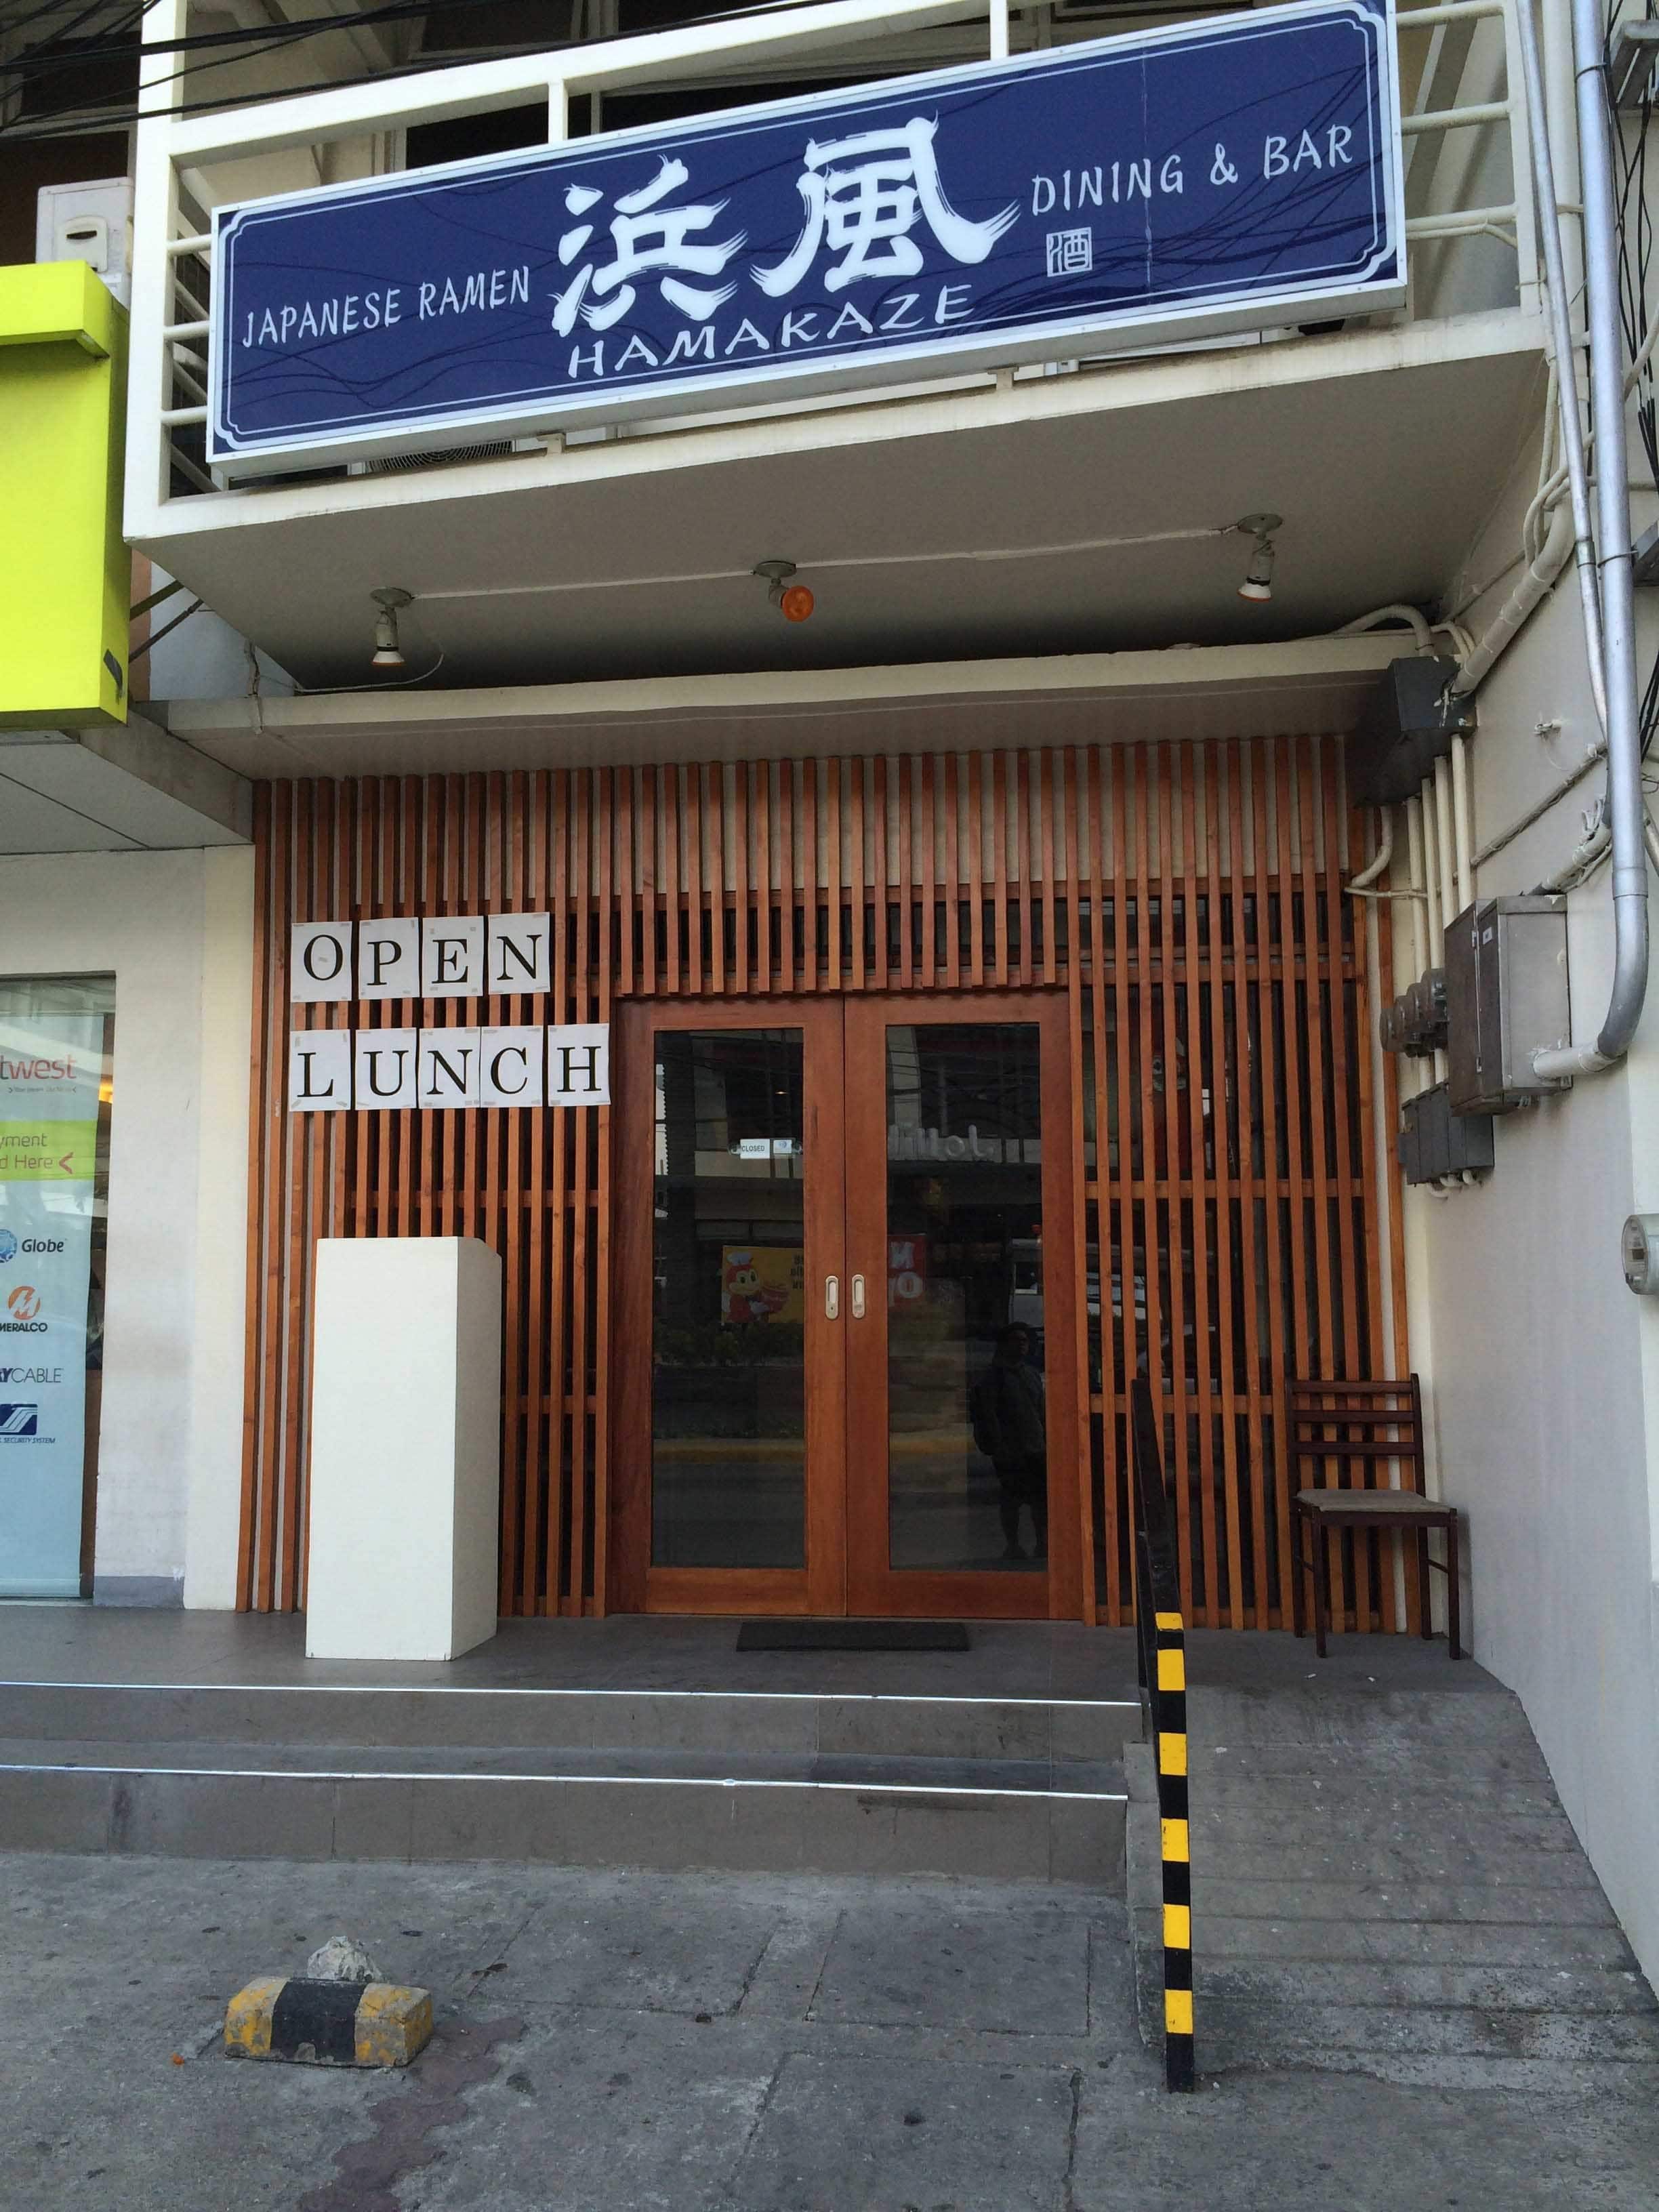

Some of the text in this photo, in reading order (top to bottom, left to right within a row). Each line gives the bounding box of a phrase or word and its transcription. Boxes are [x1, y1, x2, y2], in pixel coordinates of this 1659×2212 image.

[1031, 125, 1353, 216] DINING & BAR
[549, 110, 1020, 337] 浜風
[242, 266, 529, 348] JAPANESE RAMEN
[567, 284, 972, 379] HAMAKAZE
[303, 934, 543, 986] OPEN
[296, 1046, 602, 1098] LUNCH
[15, 1154, 54, 1169] Here
[22, 1238, 64, 1253] Globe
